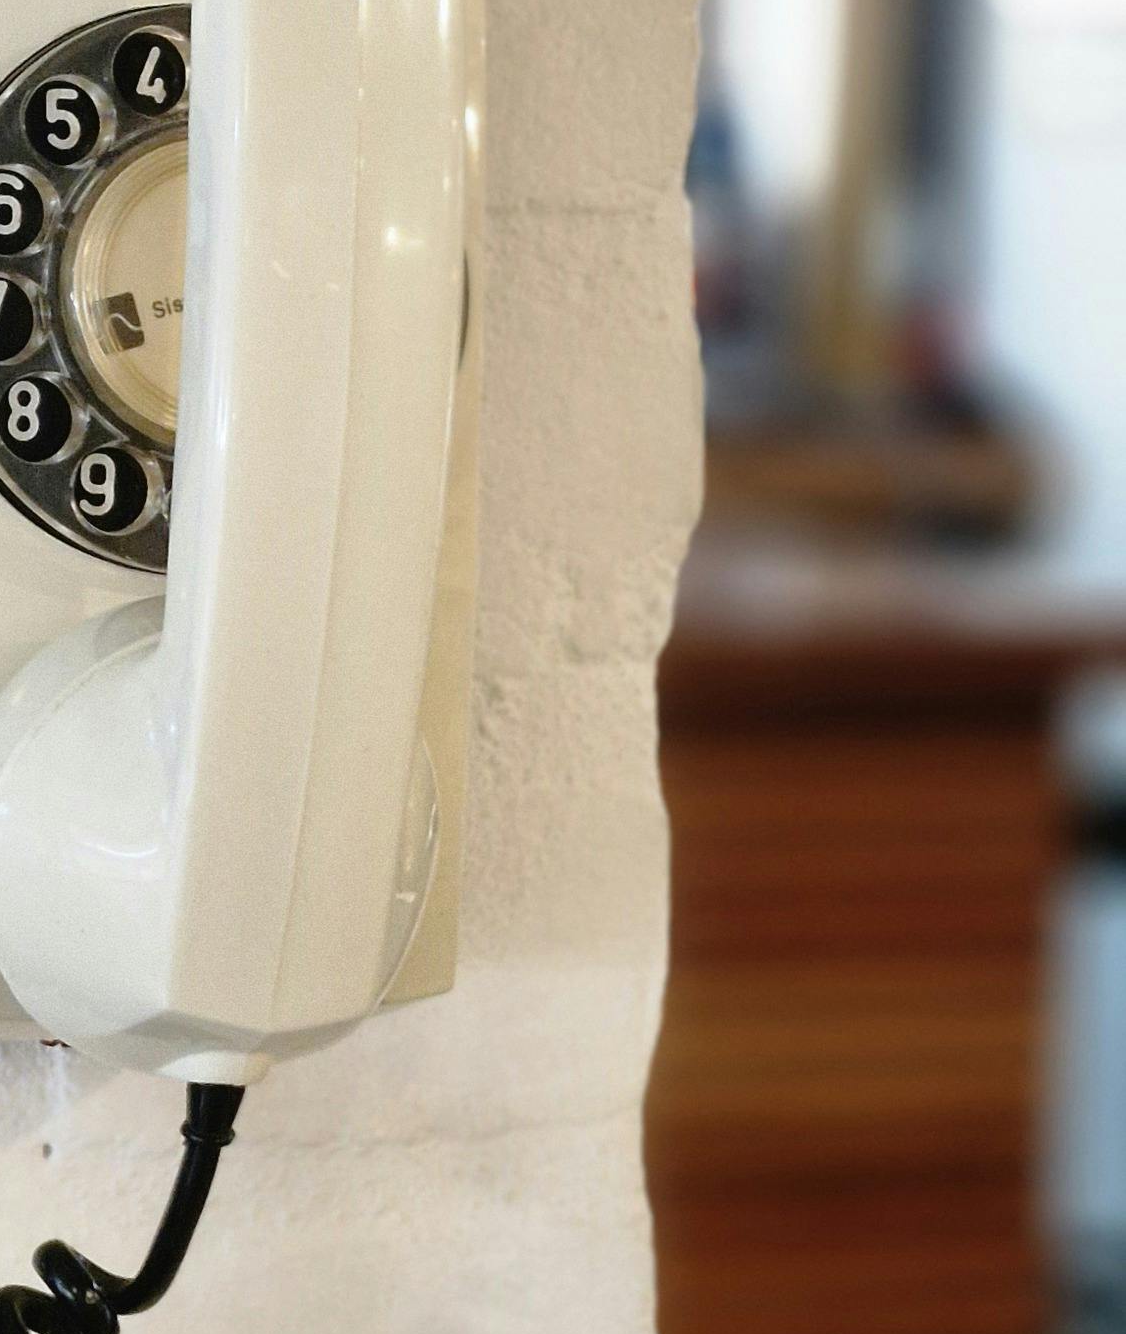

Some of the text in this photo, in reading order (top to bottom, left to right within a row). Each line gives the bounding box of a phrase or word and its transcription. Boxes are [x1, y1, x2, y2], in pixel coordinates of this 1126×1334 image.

[136, 47, 167, 104] 4
[46, 89, 81, 150] 5
[8, 381, 41, 442] 8
[79, 453, 116, 516] 9
